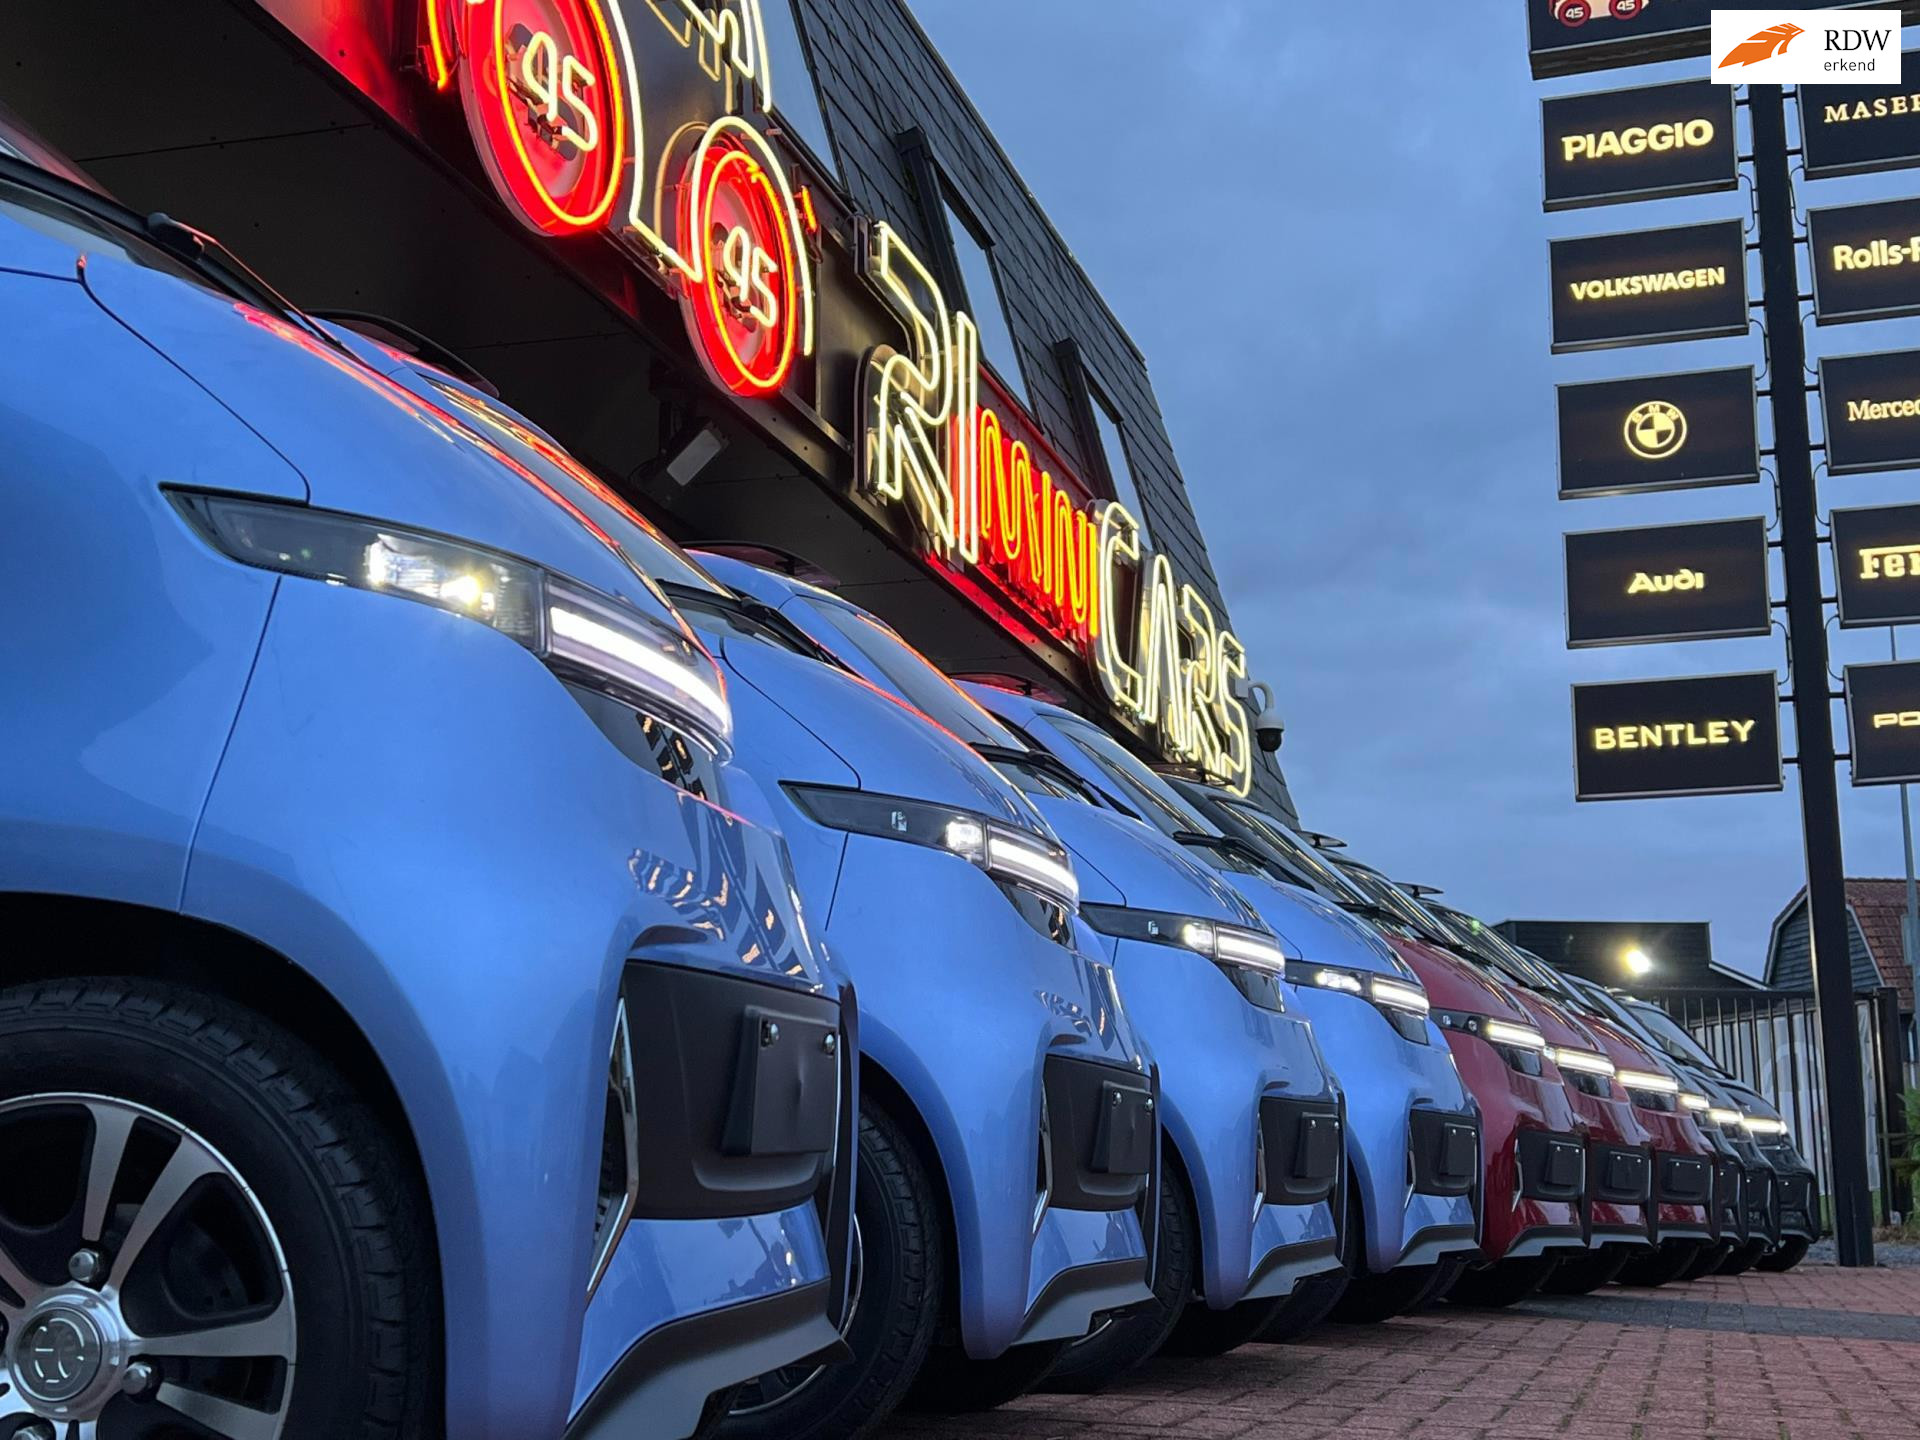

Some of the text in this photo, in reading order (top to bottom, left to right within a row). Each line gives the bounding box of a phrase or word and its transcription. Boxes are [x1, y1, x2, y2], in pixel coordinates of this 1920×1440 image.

[1565, 6, 1585, 19] 45
[1561, 119, 1714, 161] PIAGGIO
[1570, 266, 1725, 300] VOLKSWAGEN
[1627, 569, 1704, 594] Audi
[1594, 720, 1755, 751] BENTLEY
